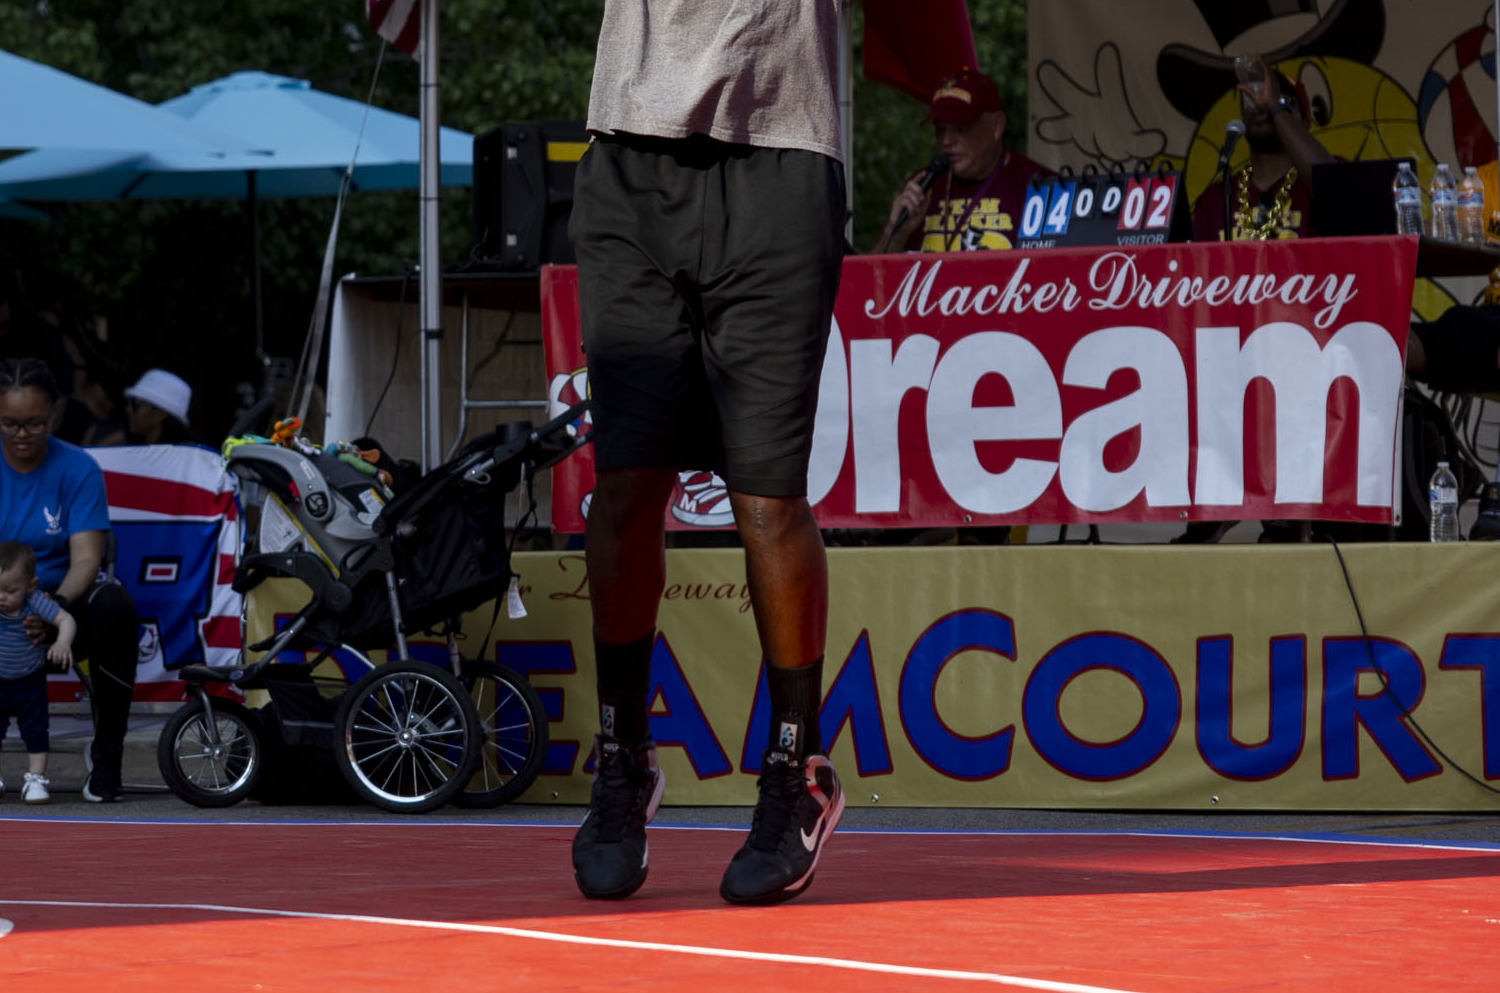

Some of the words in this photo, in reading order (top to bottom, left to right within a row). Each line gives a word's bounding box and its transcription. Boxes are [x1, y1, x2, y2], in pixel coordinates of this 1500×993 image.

[1117, 233, 1164, 247] VISITOR
[865, 257, 1082, 319] Macker
[1087, 252, 1358, 328] Driveway
